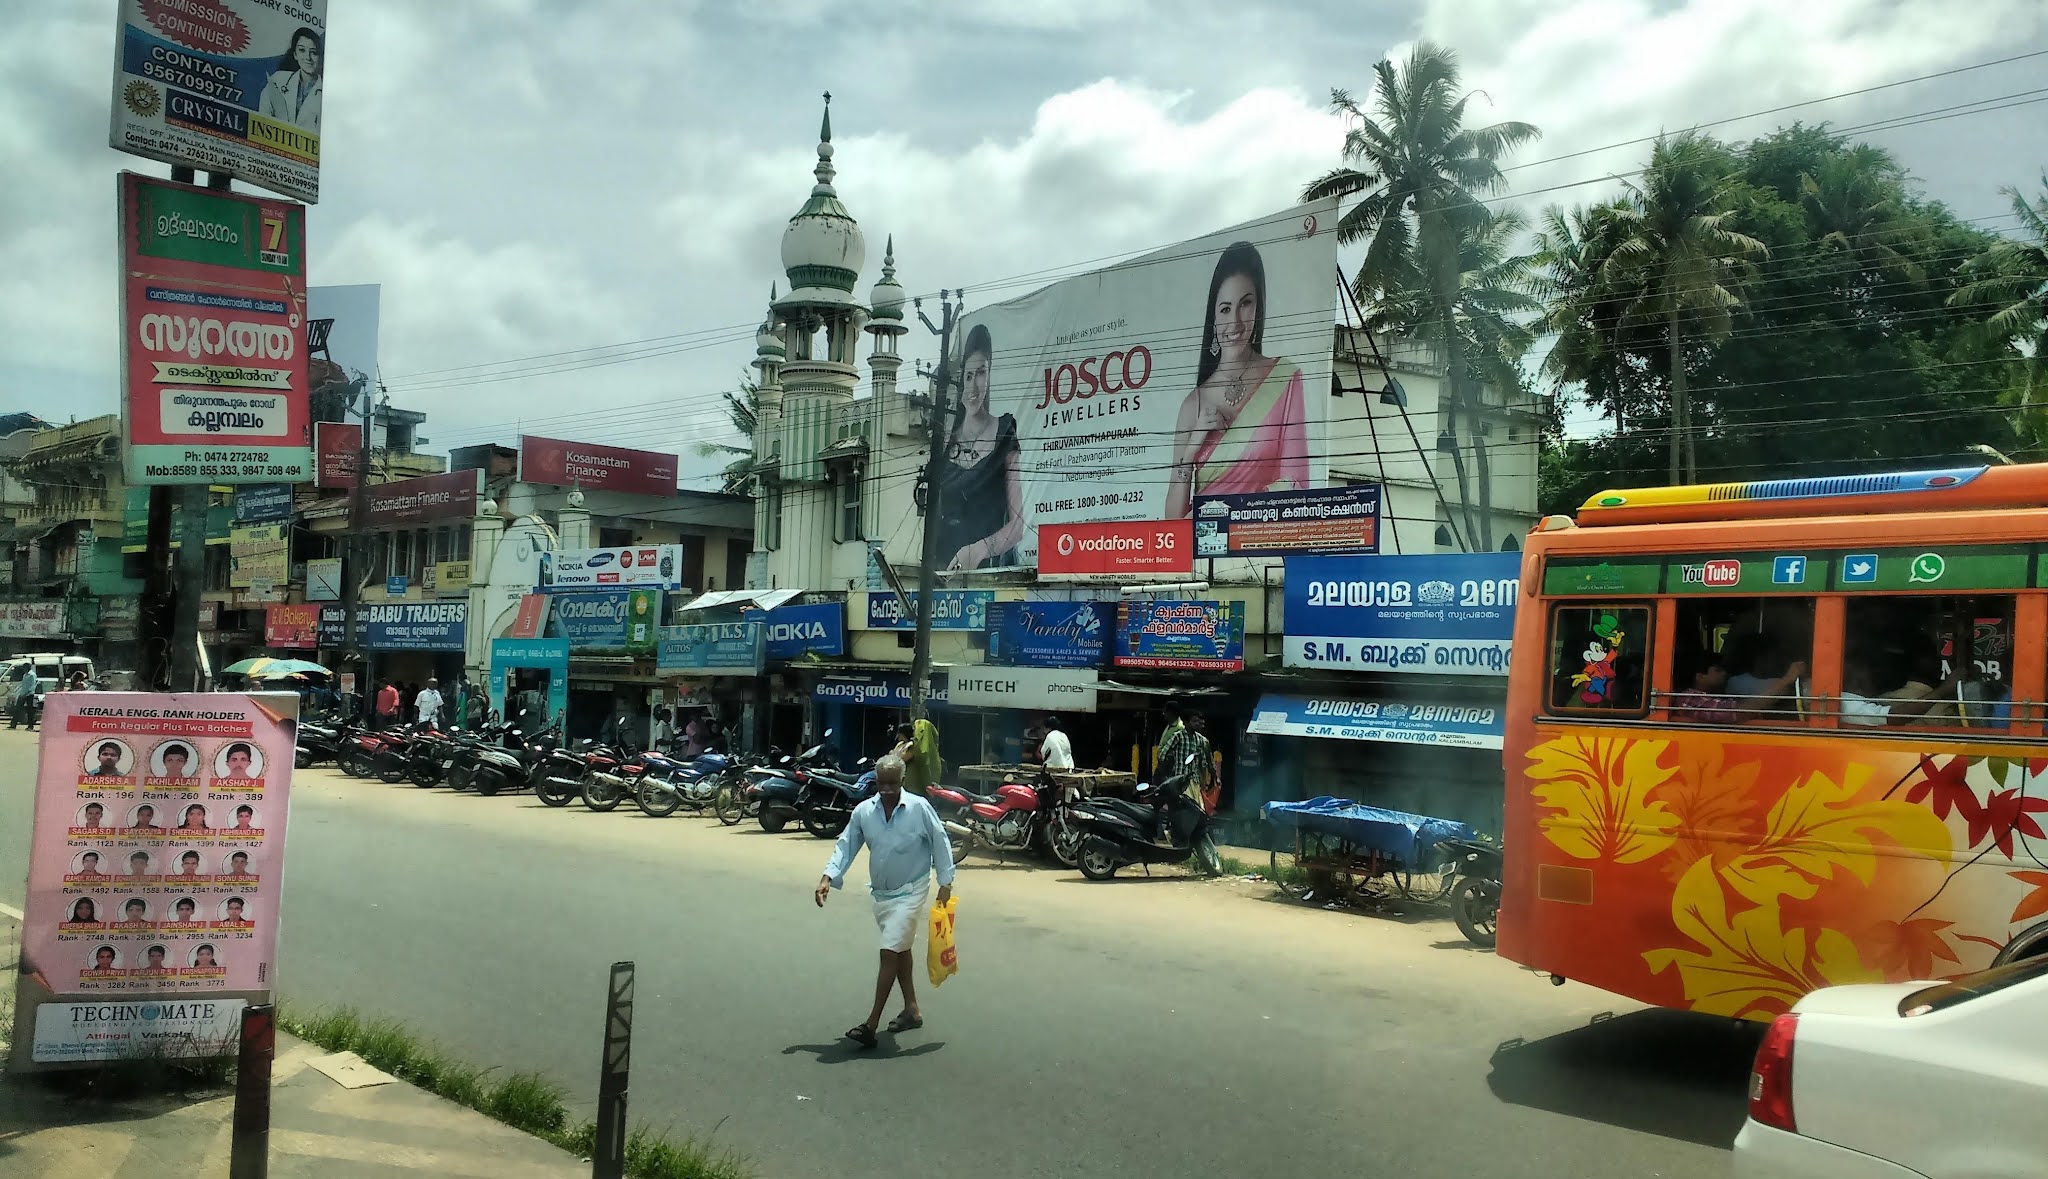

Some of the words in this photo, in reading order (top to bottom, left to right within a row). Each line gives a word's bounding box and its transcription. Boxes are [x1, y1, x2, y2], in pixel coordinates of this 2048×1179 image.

[284, 5, 325, 29] SCHOOL
[157, 13, 233, 48] CONTINUES
[151, 46, 238, 83] CONTACT
[143, 62, 243, 102] 9567099777
[171, 96, 244, 132] CRYSTAL
[251, 120, 319, 156] INSTITUTE
[125, 131, 157, 148] Contact:
[159, 141, 179, 153] 0474
[222, 158, 241, 169] 0474
[209, 145, 225, 155] MAIN
[264, 217, 282, 250] 7
[1089, 323, 1107, 337] your
[1035, 345, 1152, 409] JOSCO
[1043, 395, 1140, 428] JEWELLERS
[184, 451, 202, 462] Ph:
[204, 452, 228, 462] 0474
[229, 452, 269, 463] 2724782
[566, 451, 630, 469] Kosamattam
[200, 466, 219, 477] 855
[220, 466, 240, 478] 333,
[242, 466, 266, 477] 9847
[267, 466, 283, 477] 508
[285, 466, 301, 477] 494
[566, 463, 608, 478] Finance
[370, 496, 417, 513] Kosamattam
[418, 491, 450, 507] Finance
[1035, 502, 1053, 513] TOLL
[1056, 499, 1075, 511] FREE:
[1077, 490, 1144, 509] 1800-3000-4232
[1078, 535, 1144, 551] vodafone
[1155, 533, 1175, 549] 3G
[557, 574, 590, 583] lenovo
[1682, 564, 1737, 582] YouTube
[1307, 581, 1413, 607] മലയാള
[369, 605, 404, 622] BABU
[406, 604, 465, 622] TRADERS
[1019, 611, 1081, 647] Variety
[666, 644, 691, 653] AUTOS
[1077, 638, 1103, 648] Mobiles
[1022, 647, 1055, 655] ACCESSORIES
[1304, 642, 1351, 663] S.M.
[1361, 643, 1429, 668] ബുക്ക്
[817, 681, 888, 703] ഹോട്ടൽ
[958, 679, 1016, 693] HITECH
[1047, 682, 1084, 694] phones
[79, 707, 123, 717] KERALA
[126, 708, 160, 718] ENGG.
[163, 709, 194, 719] RANK
[197, 711, 245, 720] HOLDERS
[1305, 700, 1380, 718] മലയാള
[1409, 704, 1495, 725] മനോരമ
[92, 721, 117, 729] From
[120, 722, 159, 732] Regular
[162, 722, 182, 731] Plus
[185, 724, 204, 732] Two
[207, 724, 247, 733] Batches
[1305, 726, 1335, 736] S.M.
[1341, 728, 1385, 739] ബുക്ക്
[83, 777, 114, 785] ADARSH
[147, 778, 174, 786] AKHIL
[175, 778, 199, 786] ALAM
[216, 779, 250, 787] AKSHAY
[76, 791, 105, 799] Rank
[115, 791, 134, 799] 196
[142, 792, 170, 800] Rank
[181, 792, 199, 800] 260
[208, 793, 235, 801] Rank
[245, 793, 263, 801] 389
[86, 1032, 130, 1041] Attingal
